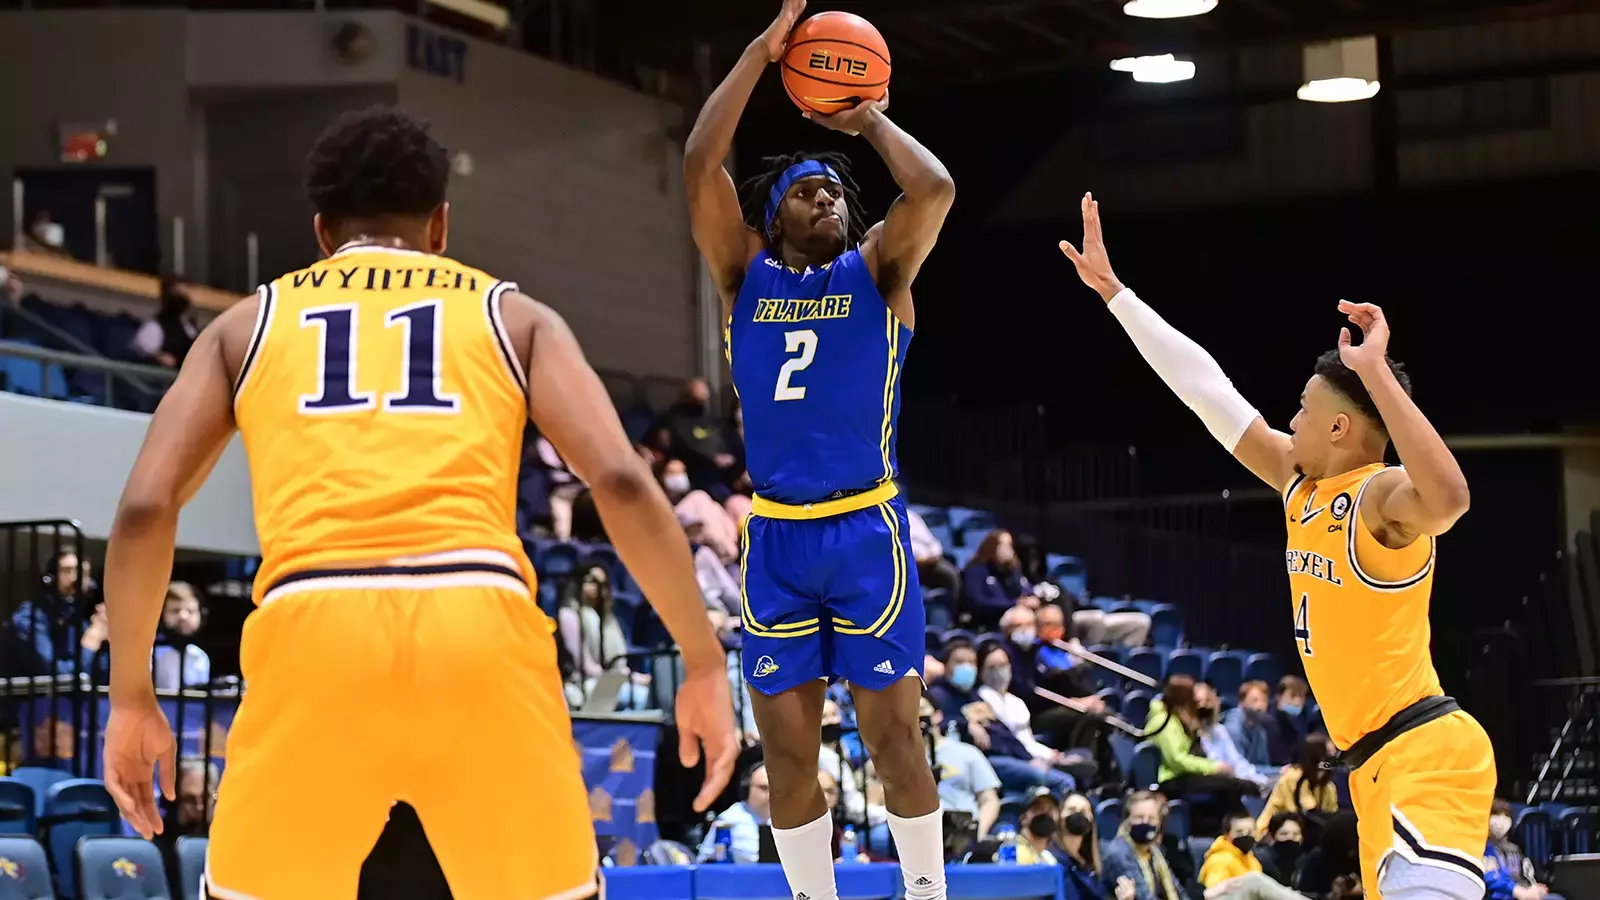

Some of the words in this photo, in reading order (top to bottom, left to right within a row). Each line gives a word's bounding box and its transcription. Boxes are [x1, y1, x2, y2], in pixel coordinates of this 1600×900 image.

[808, 52, 868, 78] ELITE
[753, 295, 852, 322] DELAWARE
[298, 298, 461, 414] 11
[774, 329, 819, 401] 2
[1286, 549, 1342, 587] REXEL
[1294, 592, 1313, 656] 4
